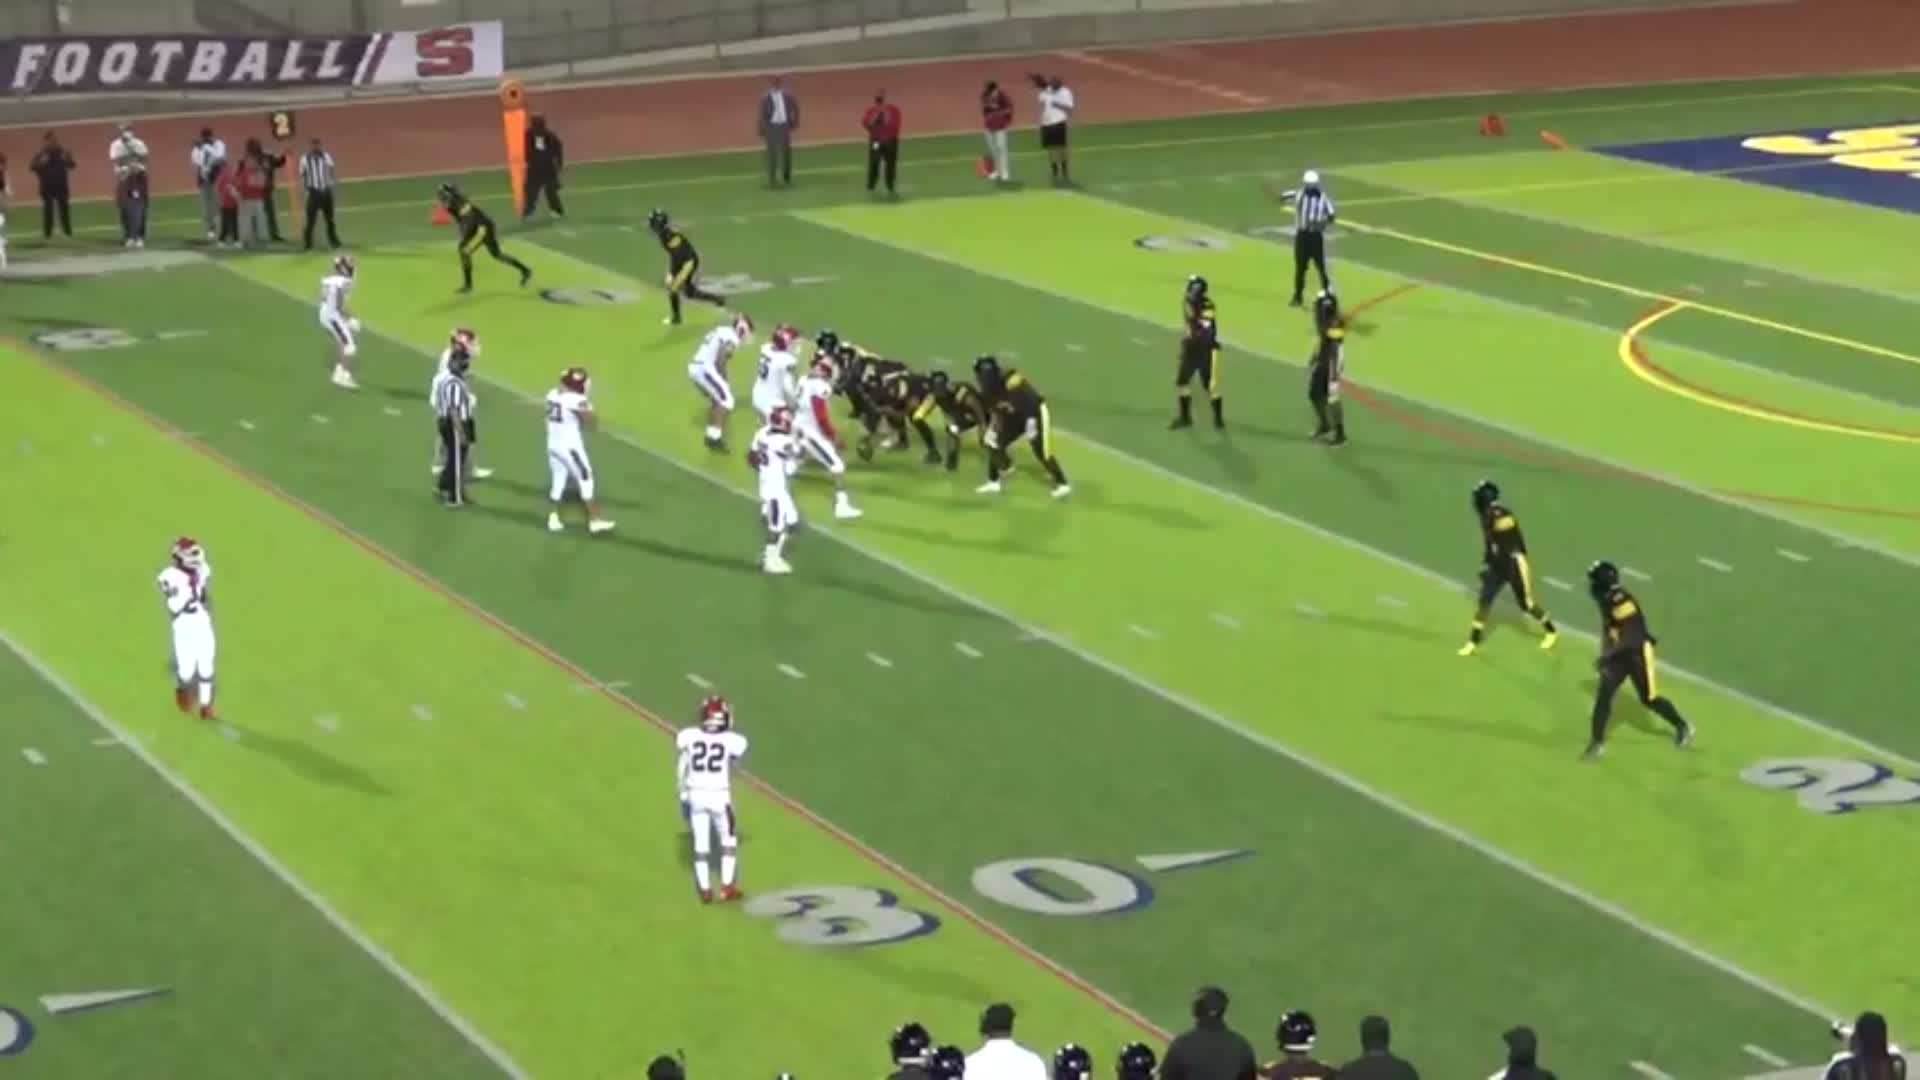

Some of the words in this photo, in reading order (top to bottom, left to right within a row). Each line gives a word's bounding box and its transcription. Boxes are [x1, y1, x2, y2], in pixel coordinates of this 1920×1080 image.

[10, 39, 345, 89] FOOTBALL
[416, 26, 475, 77] S
[273, 113, 289, 137] 2
[691, 741, 726, 773] 22
